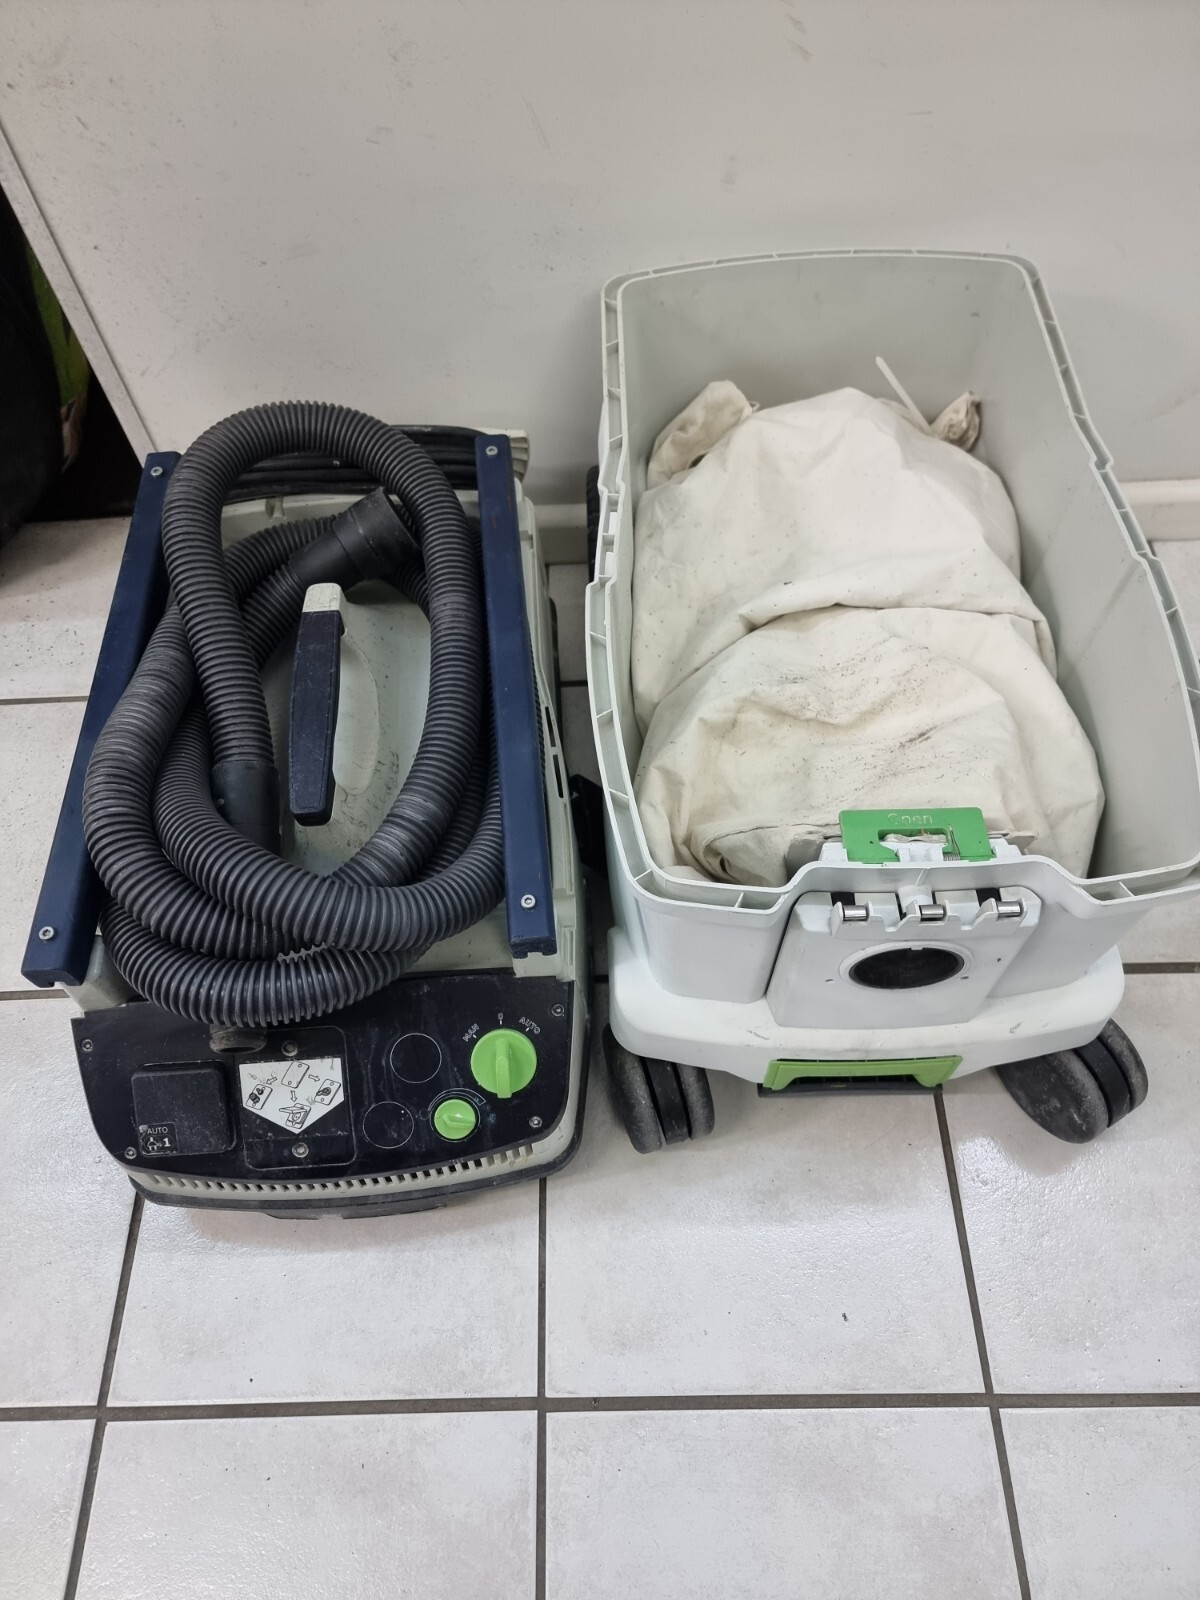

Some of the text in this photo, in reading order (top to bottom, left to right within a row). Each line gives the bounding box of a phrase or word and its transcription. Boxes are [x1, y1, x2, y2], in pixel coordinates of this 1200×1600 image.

[462, 1023, 480, 1042] MAN
[518, 1016, 541, 1035] AUTO
[147, 1126, 168, 1135] AUTO
[163, 1137, 171, 1147] 1
